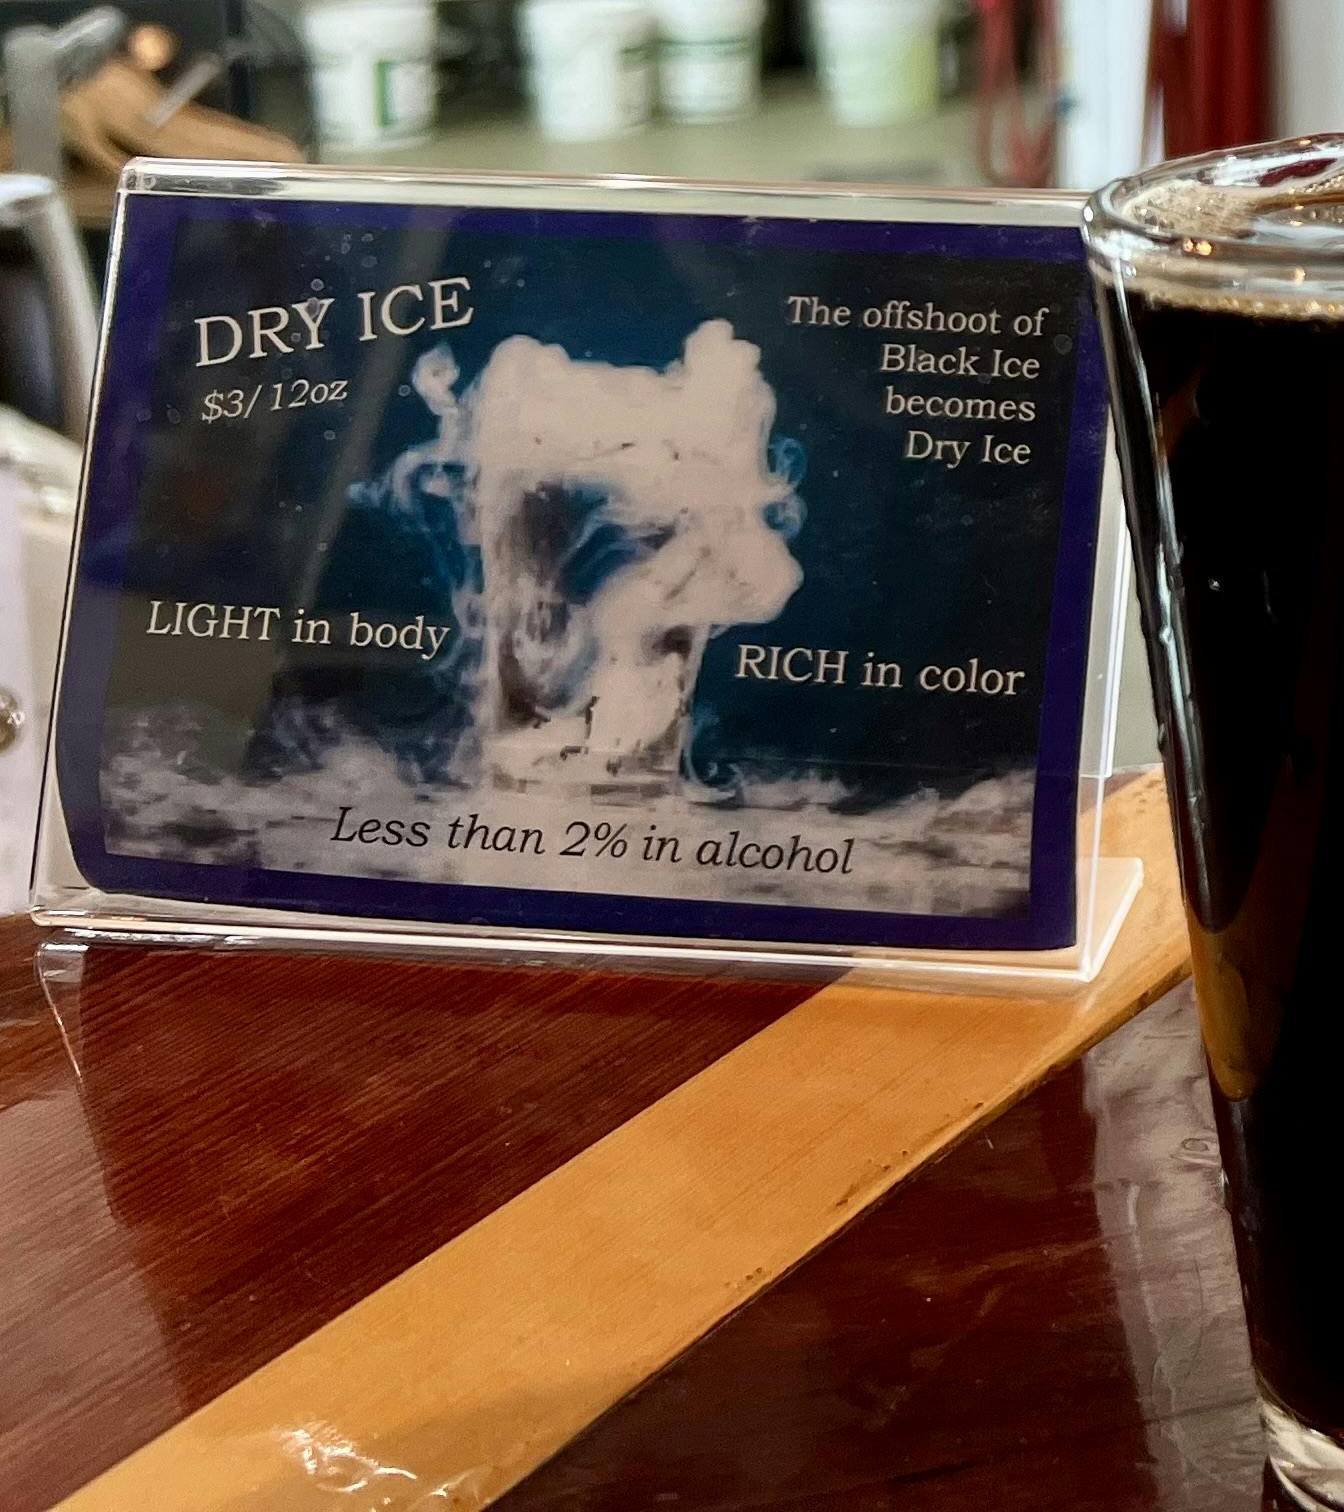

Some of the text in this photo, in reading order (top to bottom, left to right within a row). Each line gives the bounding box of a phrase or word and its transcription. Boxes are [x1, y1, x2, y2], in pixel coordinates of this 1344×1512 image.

[193, 276, 474, 367] DRY ICE
[787, 295, 1050, 336] The offshoot of
[879, 343, 1040, 379] Black Ice
[885, 385, 1036, 422] becomes
[905, 430, 1031, 469] Dry Ice
[146, 600, 451, 661] LIGHT in body
[734, 644, 1026, 695] RICH in color
[326, 806, 855, 875] Less than 2% in alcohol
